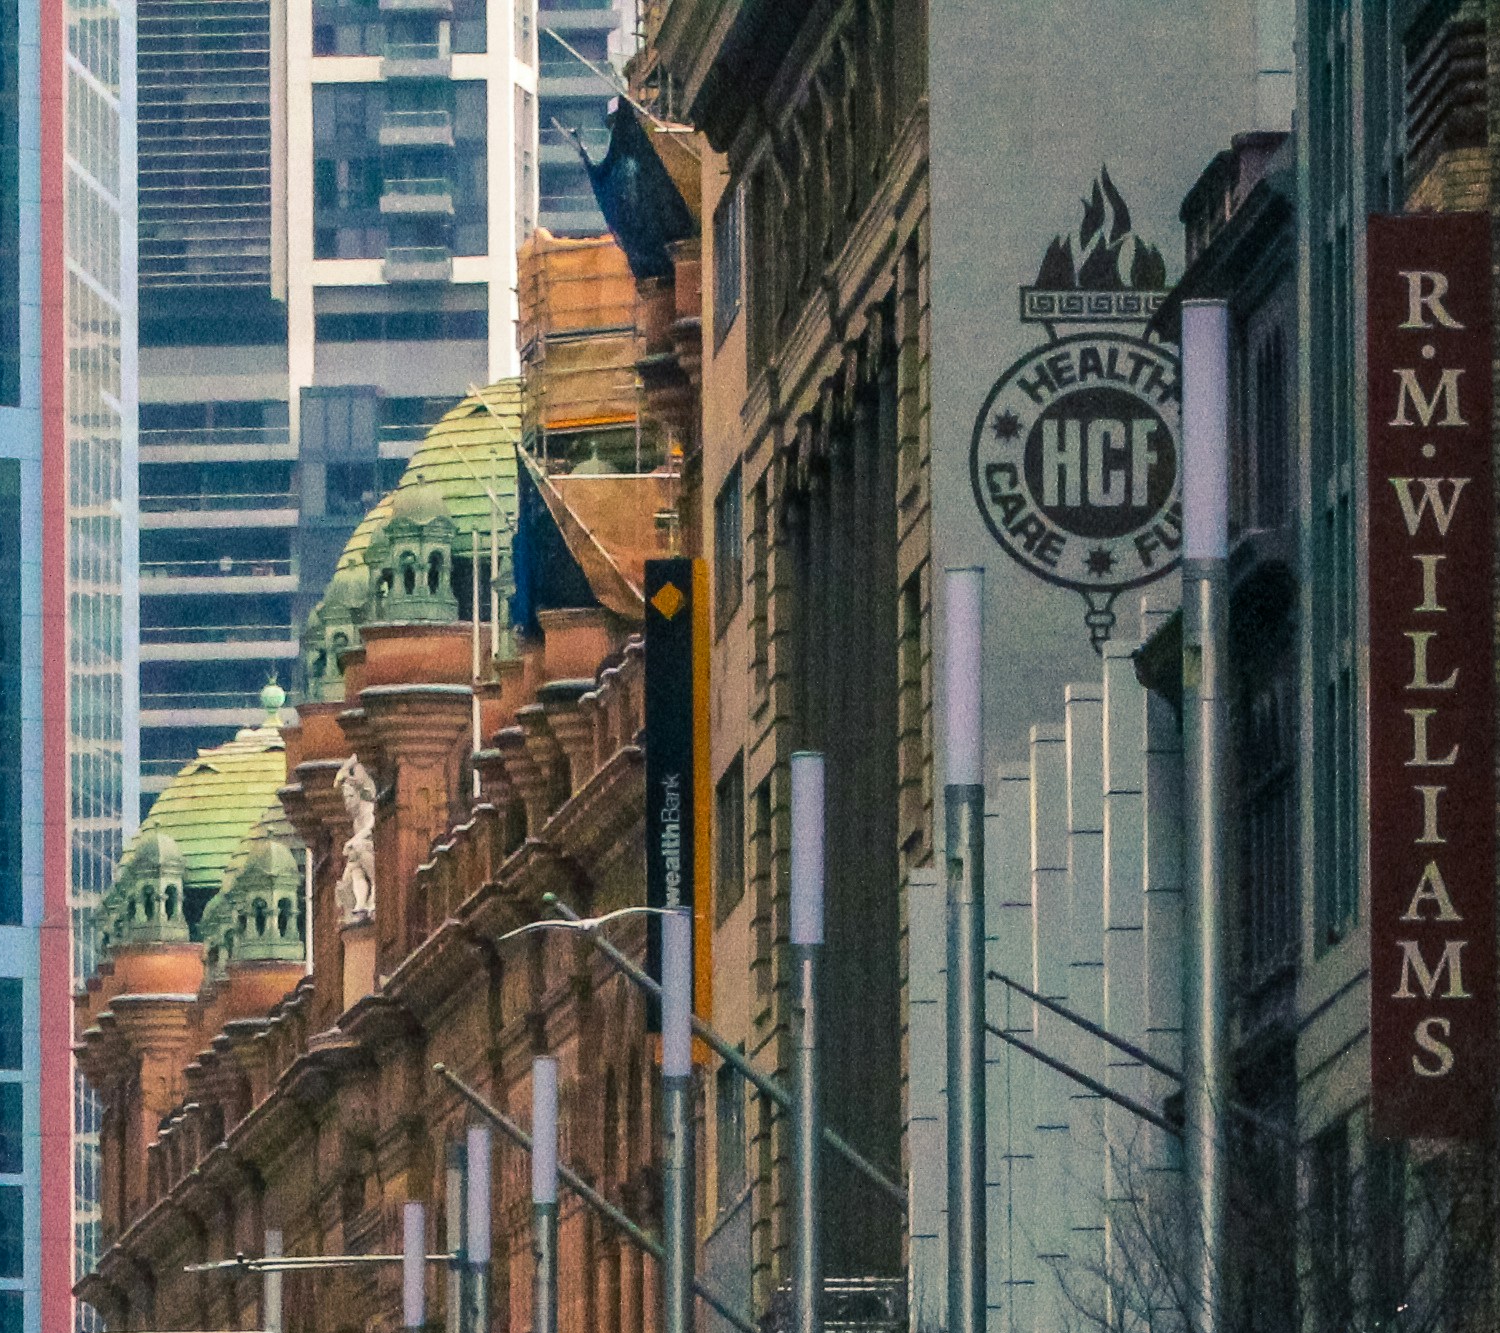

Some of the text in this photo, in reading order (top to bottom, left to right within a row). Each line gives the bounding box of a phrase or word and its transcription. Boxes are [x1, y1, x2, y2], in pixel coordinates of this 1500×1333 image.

[1016, 346, 1177, 405] HEALTH
[1042, 418, 1158, 507] HCF
[985, 463, 1067, 568] CARE
[1133, 500, 1184, 568] FU
